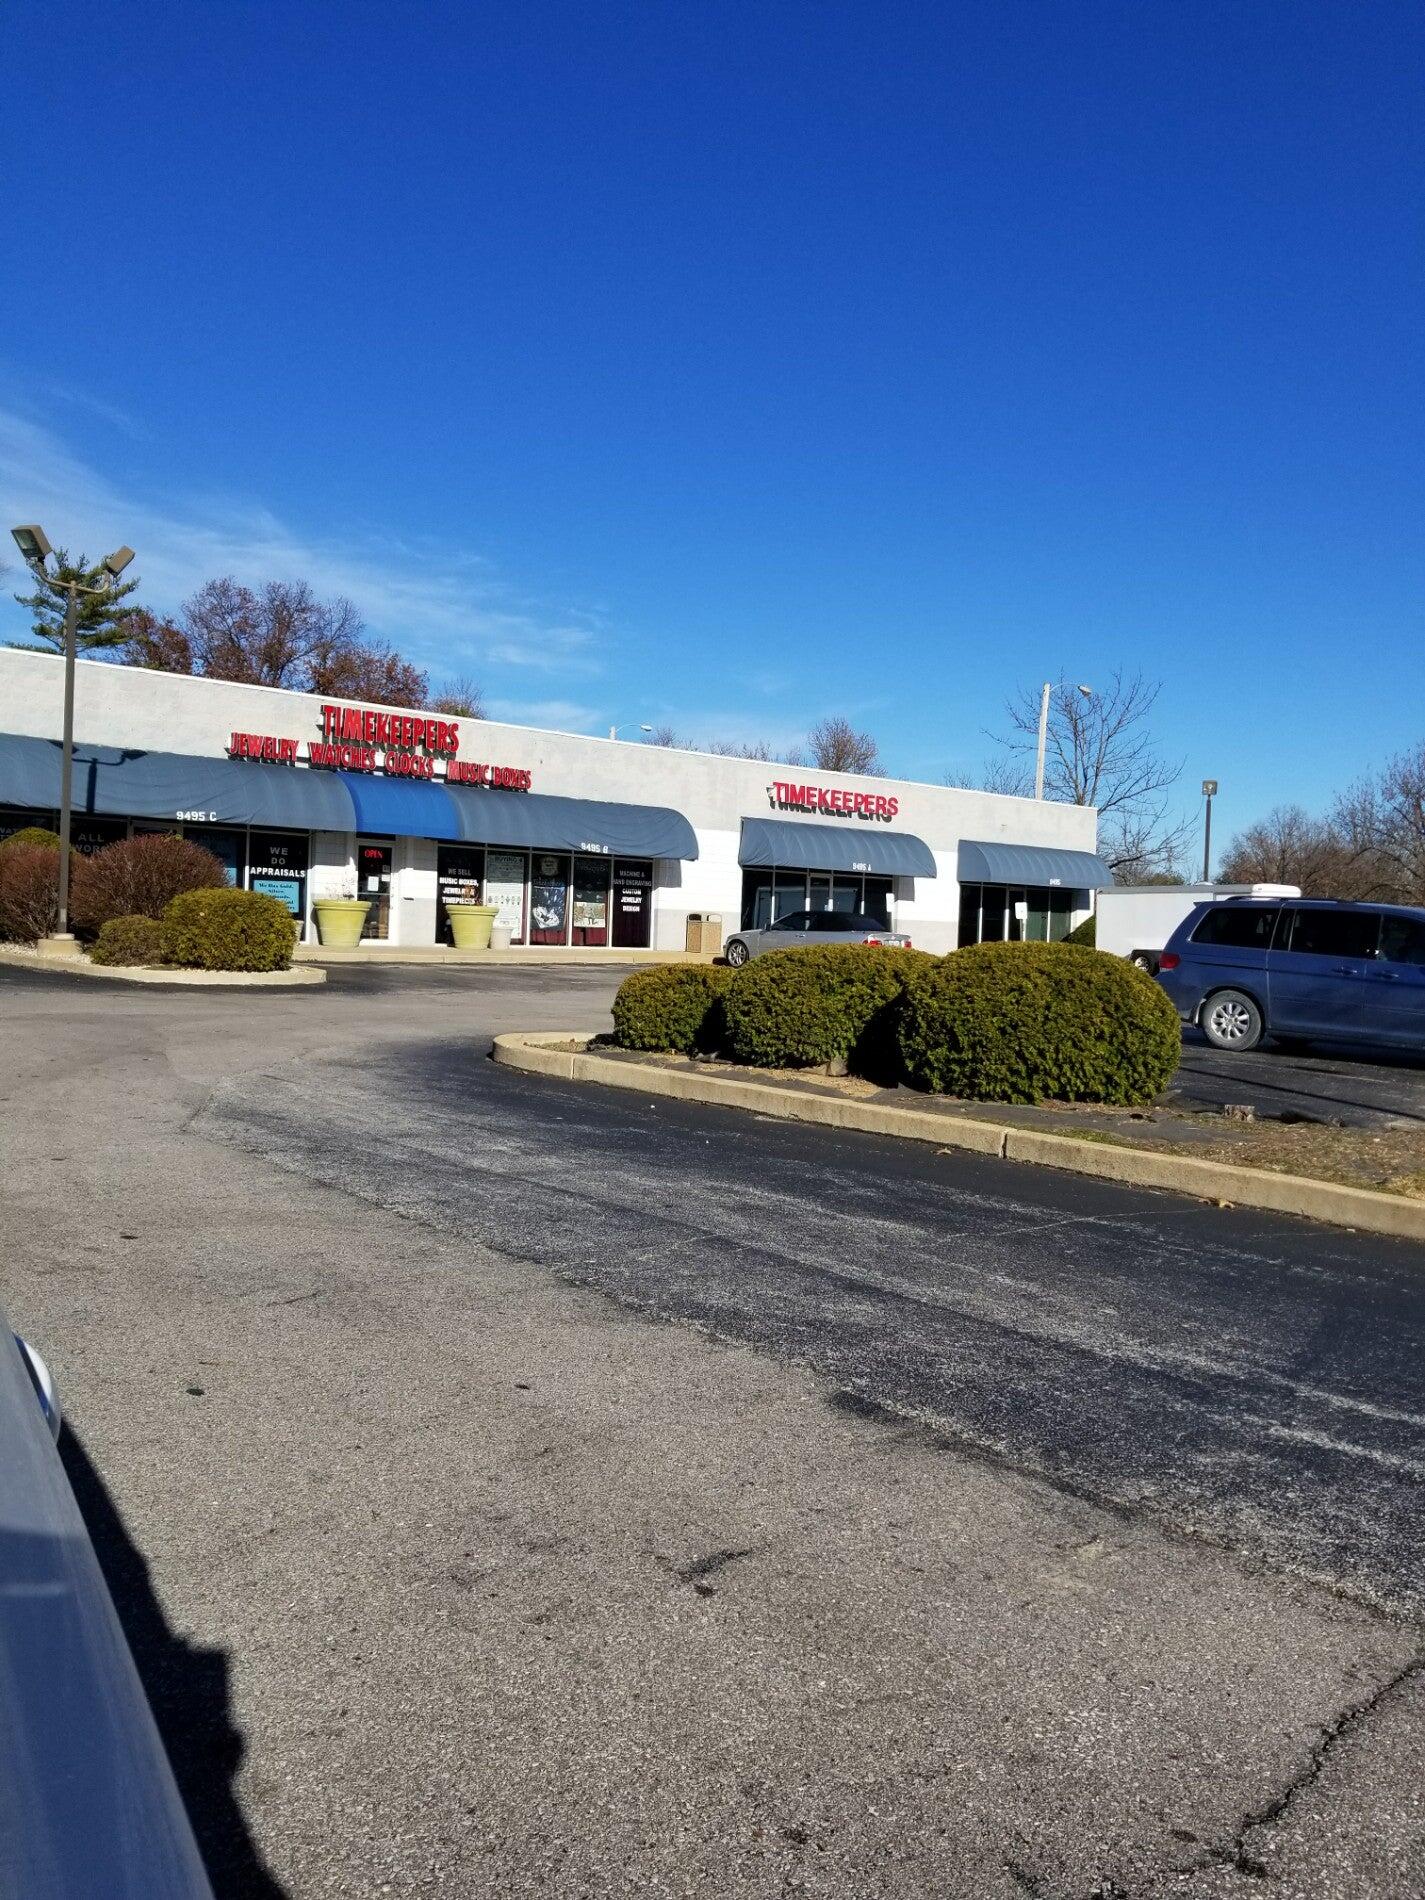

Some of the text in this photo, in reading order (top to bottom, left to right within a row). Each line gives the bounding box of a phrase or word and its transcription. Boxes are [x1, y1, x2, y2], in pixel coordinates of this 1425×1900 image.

[321, 705, 460, 752] TIMEKEEPERS
[230, 732, 532, 790] JEWELRY WATCHES CLOCKS MUSIC BOXES
[772, 781, 899, 816] TIMEKEEPERS
[176, 811, 217, 822] 9495 C
[78, 833, 105, 842] ALL
[269, 846, 289, 856] WE
[364, 849, 383, 859] OPEN
[271, 857, 286, 865] DO
[250, 866, 307, 878] APPRAISALS
[439, 876, 458, 885] MUSIC
